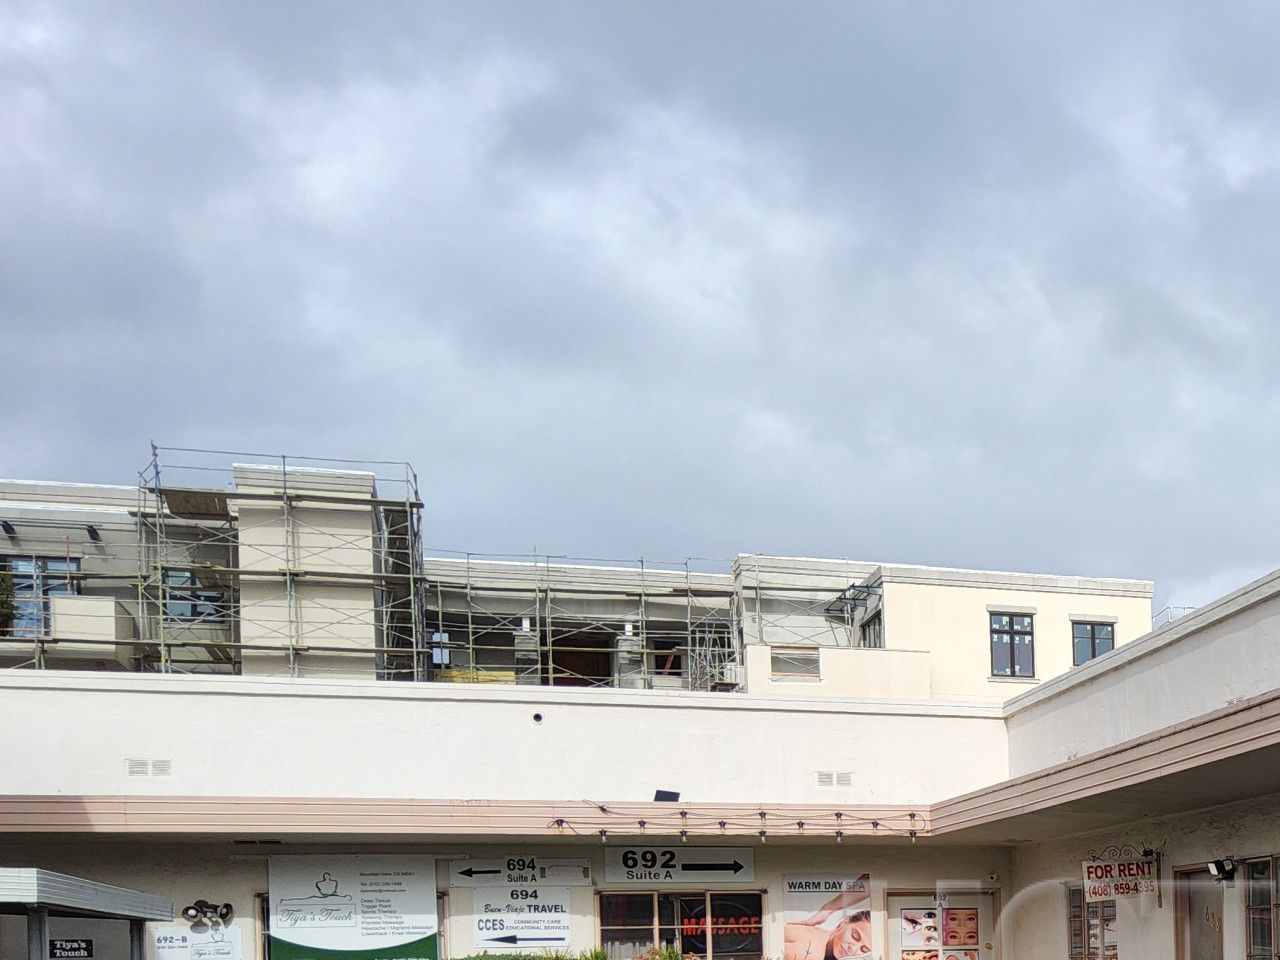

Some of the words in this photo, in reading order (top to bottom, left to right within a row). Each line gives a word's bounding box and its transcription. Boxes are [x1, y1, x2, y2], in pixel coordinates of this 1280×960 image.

[622, 850, 677, 869] 692
[506, 858, 537, 872] 694
[626, 870, 661, 880] Suite
[663, 871, 673, 879] A
[1086, 864, 1114, 880] FOR
[1117, 861, 1153, 878] RENT
[507, 874, 529, 882] Suite
[787, 881, 821, 890] WARM
[824, 881, 844, 890] DAY
[846, 881, 865, 890] SPA
[510, 889, 539, 900] 694
[1088, 884, 1112, 898] (408)
[526, 904, 567, 913] TRAVEL
[279, 908, 316, 928] Tiya's
[319, 908, 353, 921] Touch
[477, 919, 505, 930] CCES
[54, 940, 87, 949] Tiya's
[156, 935, 188, 944] 692-B
[54, 949, 88, 957] Touch
